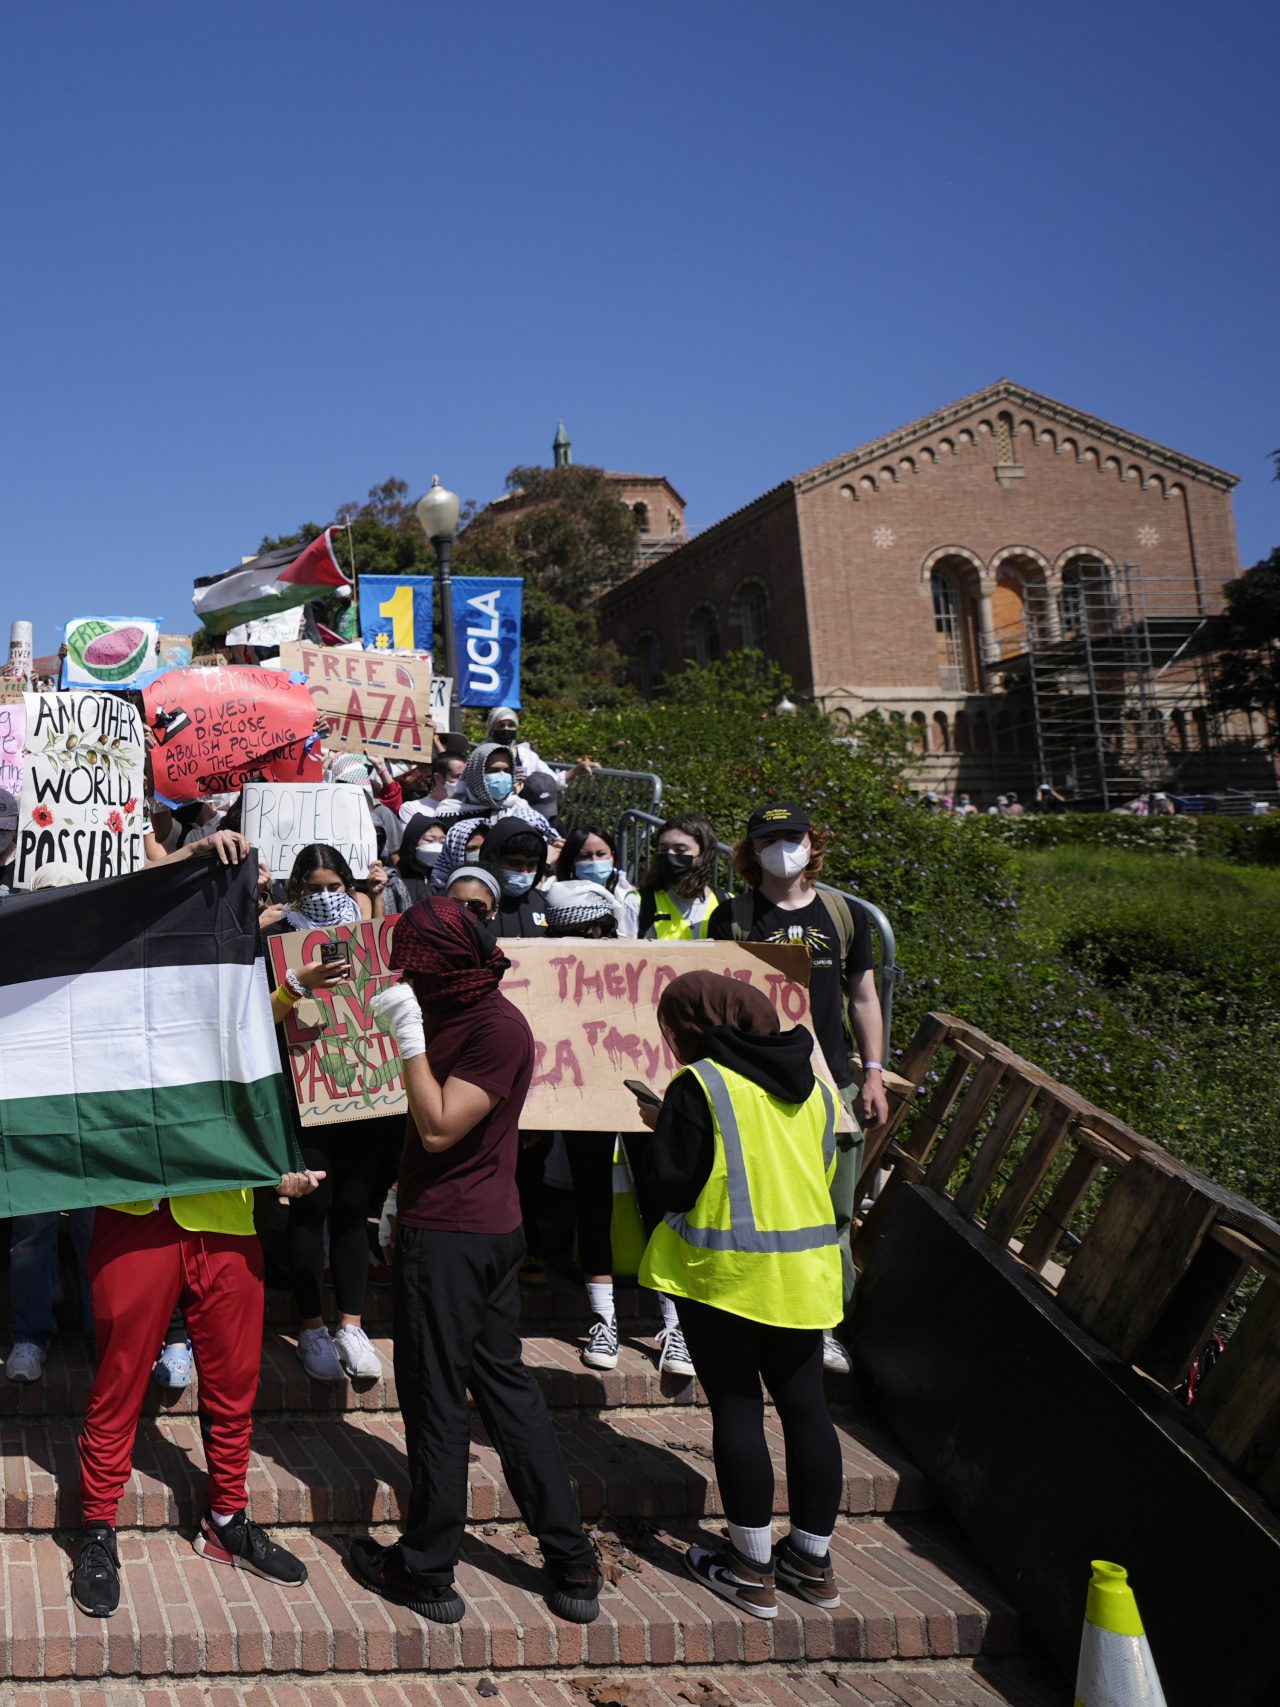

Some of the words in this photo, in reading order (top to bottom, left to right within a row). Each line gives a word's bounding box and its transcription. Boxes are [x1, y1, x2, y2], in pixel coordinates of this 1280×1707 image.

[375, 586, 414, 650] #1
[466, 590, 501, 694] UCLA
[302, 652, 387, 688] FREE
[34, 695, 140, 747] ANOTHER
[194, 698, 261, 724] DIVEST
[195, 716, 266, 740] DISCLOSE
[165, 738, 221, 763] ABOLISH
[230, 728, 297, 751] POLICING
[32, 765, 132, 806] WORLD
[168, 761, 199, 782] END
[207, 754, 235, 770] THE
[84, 808, 99, 824] IS
[244, 787, 364, 841] PROTECT
[549, 954, 648, 1003] THEY
[764, 973, 807, 1021] TO
[282, 975, 403, 1043] LIV
